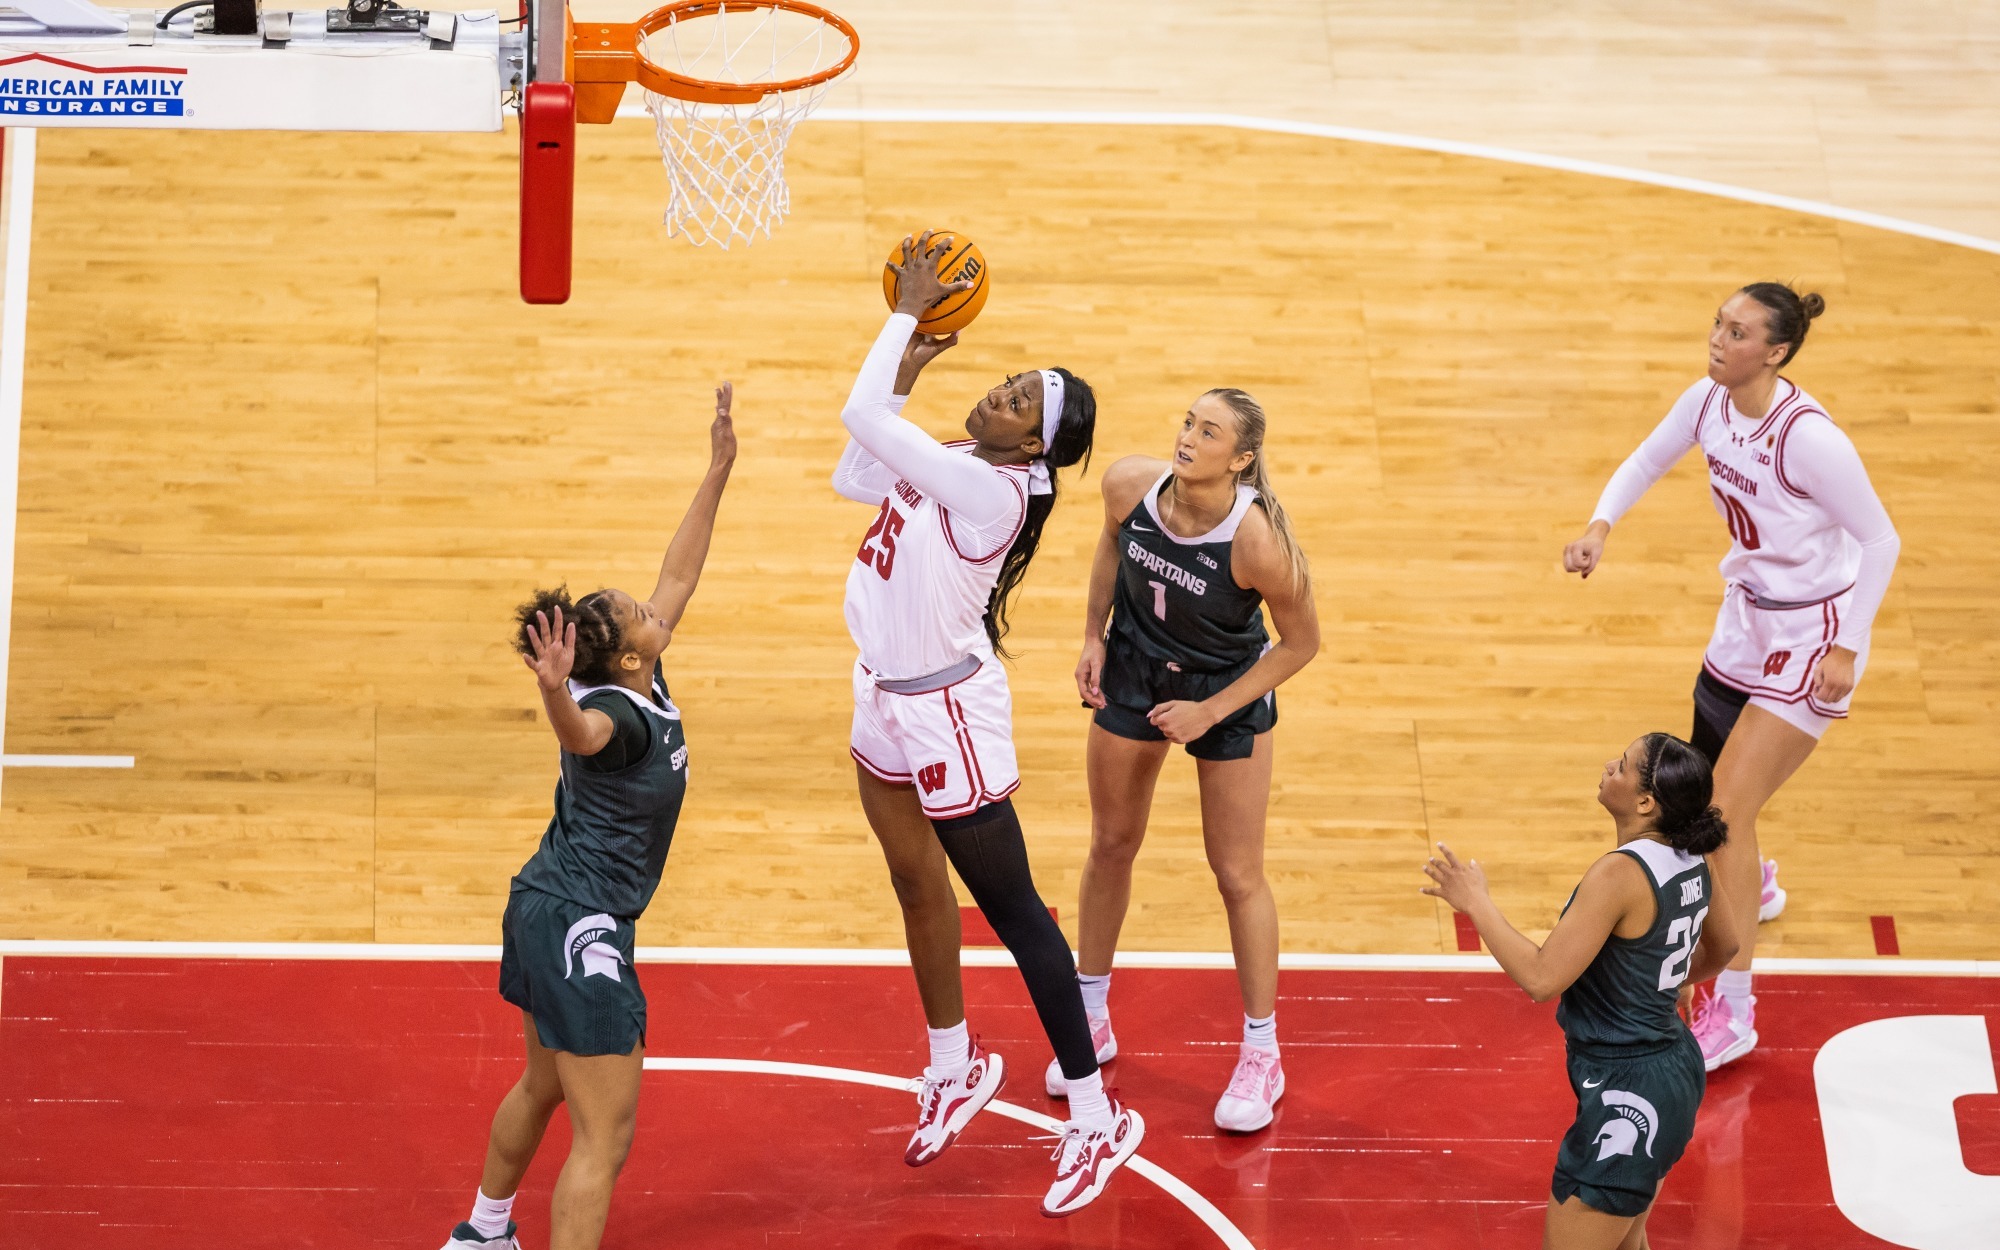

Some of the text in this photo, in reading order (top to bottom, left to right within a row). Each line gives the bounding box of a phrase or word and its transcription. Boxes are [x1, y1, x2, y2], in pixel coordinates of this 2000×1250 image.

[0, 79, 183, 95] MERICAN FAMILY
[3, 100, 167, 113] NSURANCE
[857, 497, 905, 581] 25
[1127, 540, 1207, 596] SPARTANS
[1148, 580, 1166, 622] 1
[1763, 651, 1791, 678] W
[917, 761, 947, 797] W
